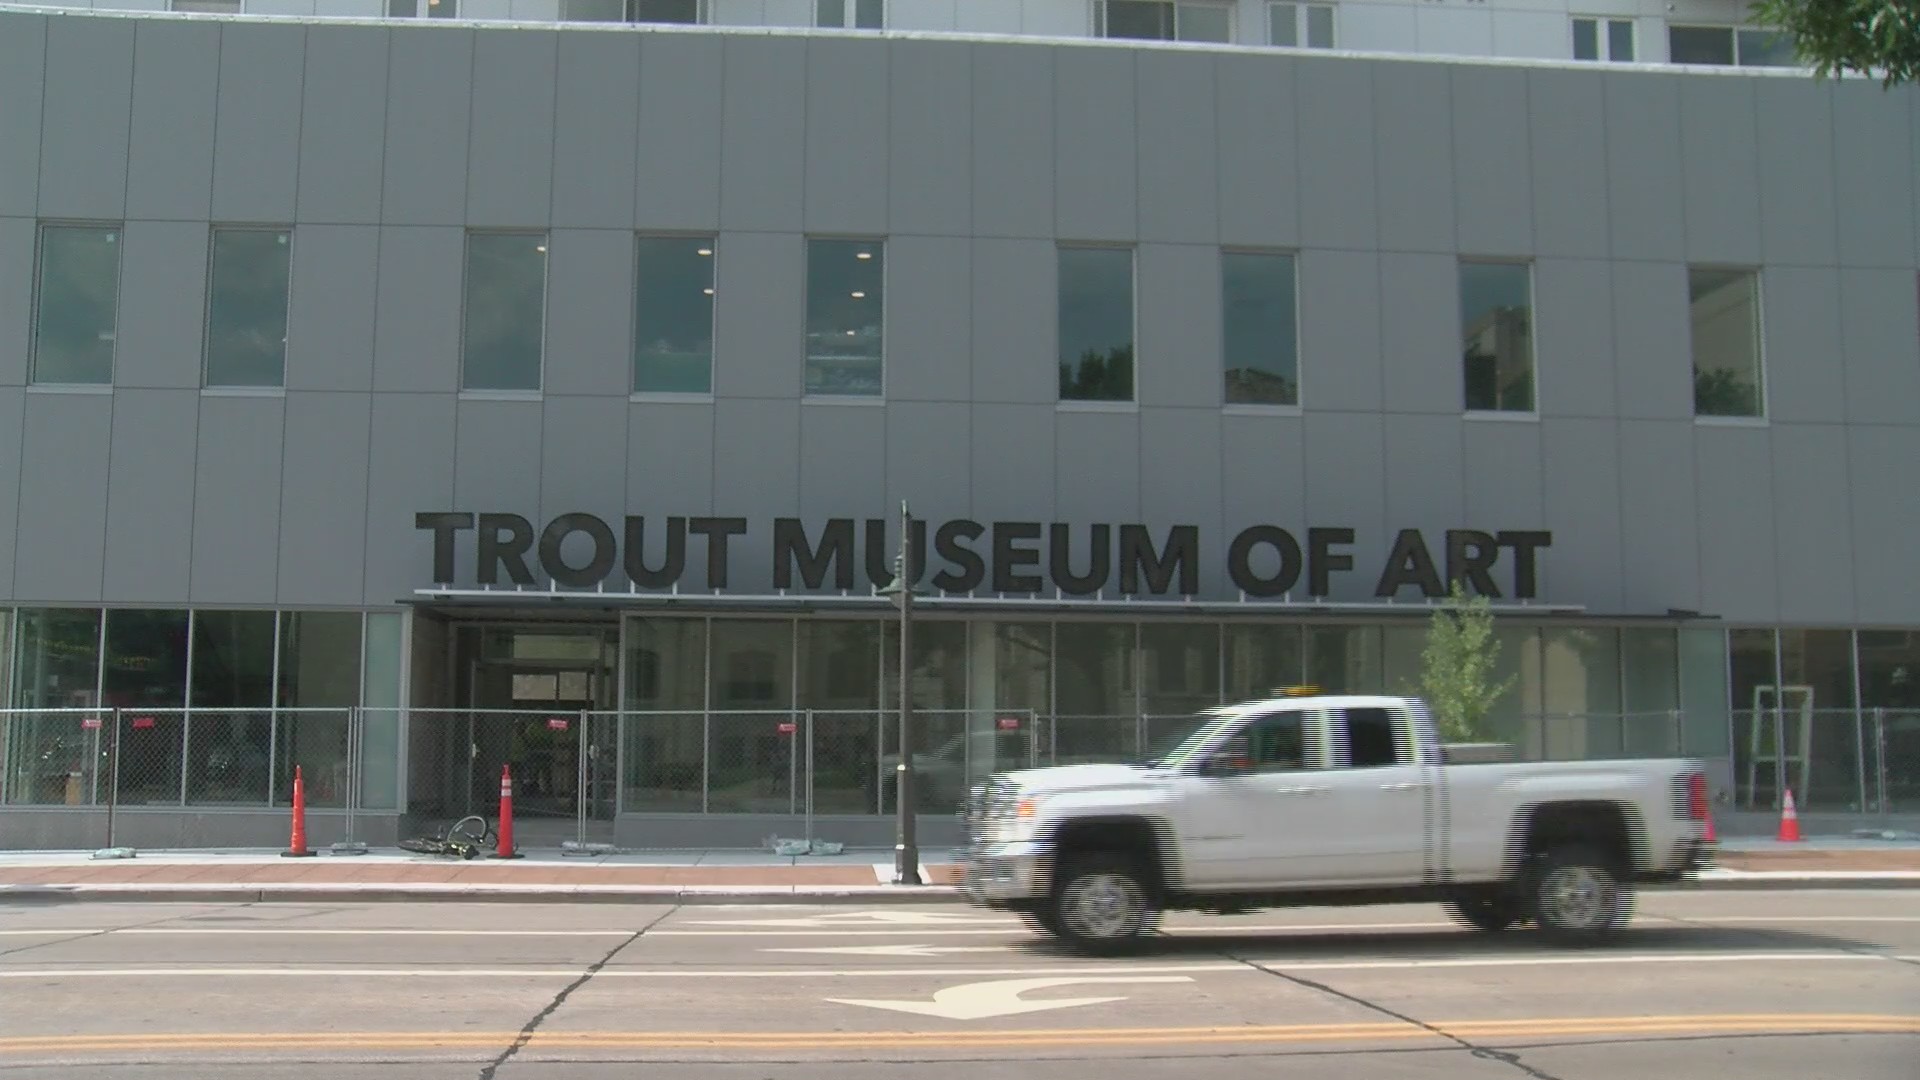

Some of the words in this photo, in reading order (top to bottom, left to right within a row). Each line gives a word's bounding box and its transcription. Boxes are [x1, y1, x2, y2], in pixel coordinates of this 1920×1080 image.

[415, 511, 747, 589] TROUT
[773, 517, 1198, 595] MUSEUM
[1228, 525, 1354, 597] OF
[1375, 529, 1552, 598] ART
